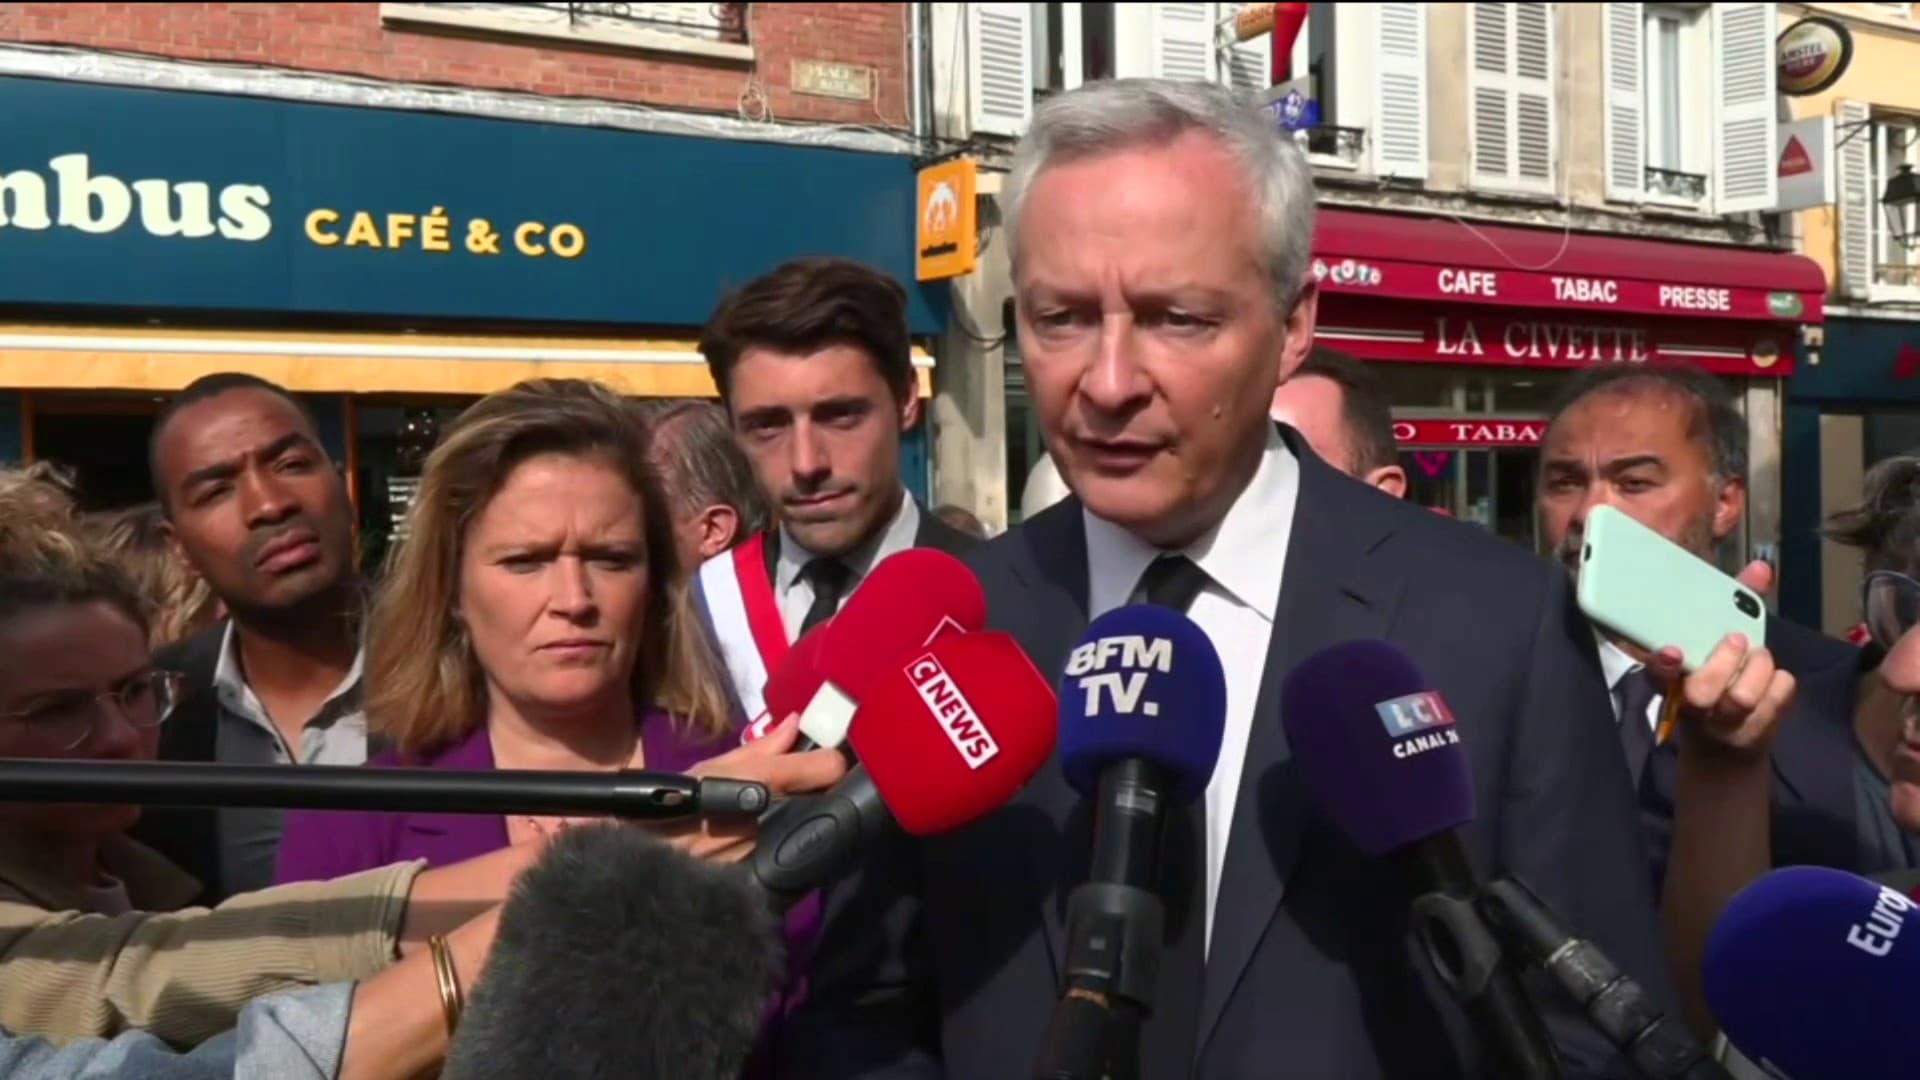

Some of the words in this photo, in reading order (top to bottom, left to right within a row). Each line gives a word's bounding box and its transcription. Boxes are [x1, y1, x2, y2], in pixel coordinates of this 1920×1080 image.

[304, 206, 450, 250] CAFÉ
[465, 219, 499, 254] &
[514, 222, 585, 258] CO
[1438, 269, 1497, 296] CAFE
[1552, 277, 1618, 303] TABAC
[1659, 286, 1731, 311] PRESSE
[1436, 317, 1485, 355] LA
[1504, 321, 1648, 362] CIVETTE
[1450, 423, 1546, 441] TABA
[1064, 635, 1173, 675] BFM
[1079, 672, 1159, 717] TV.
[1390, 695, 1444, 729] LCI
[1393, 731, 1447, 758] CANAL
